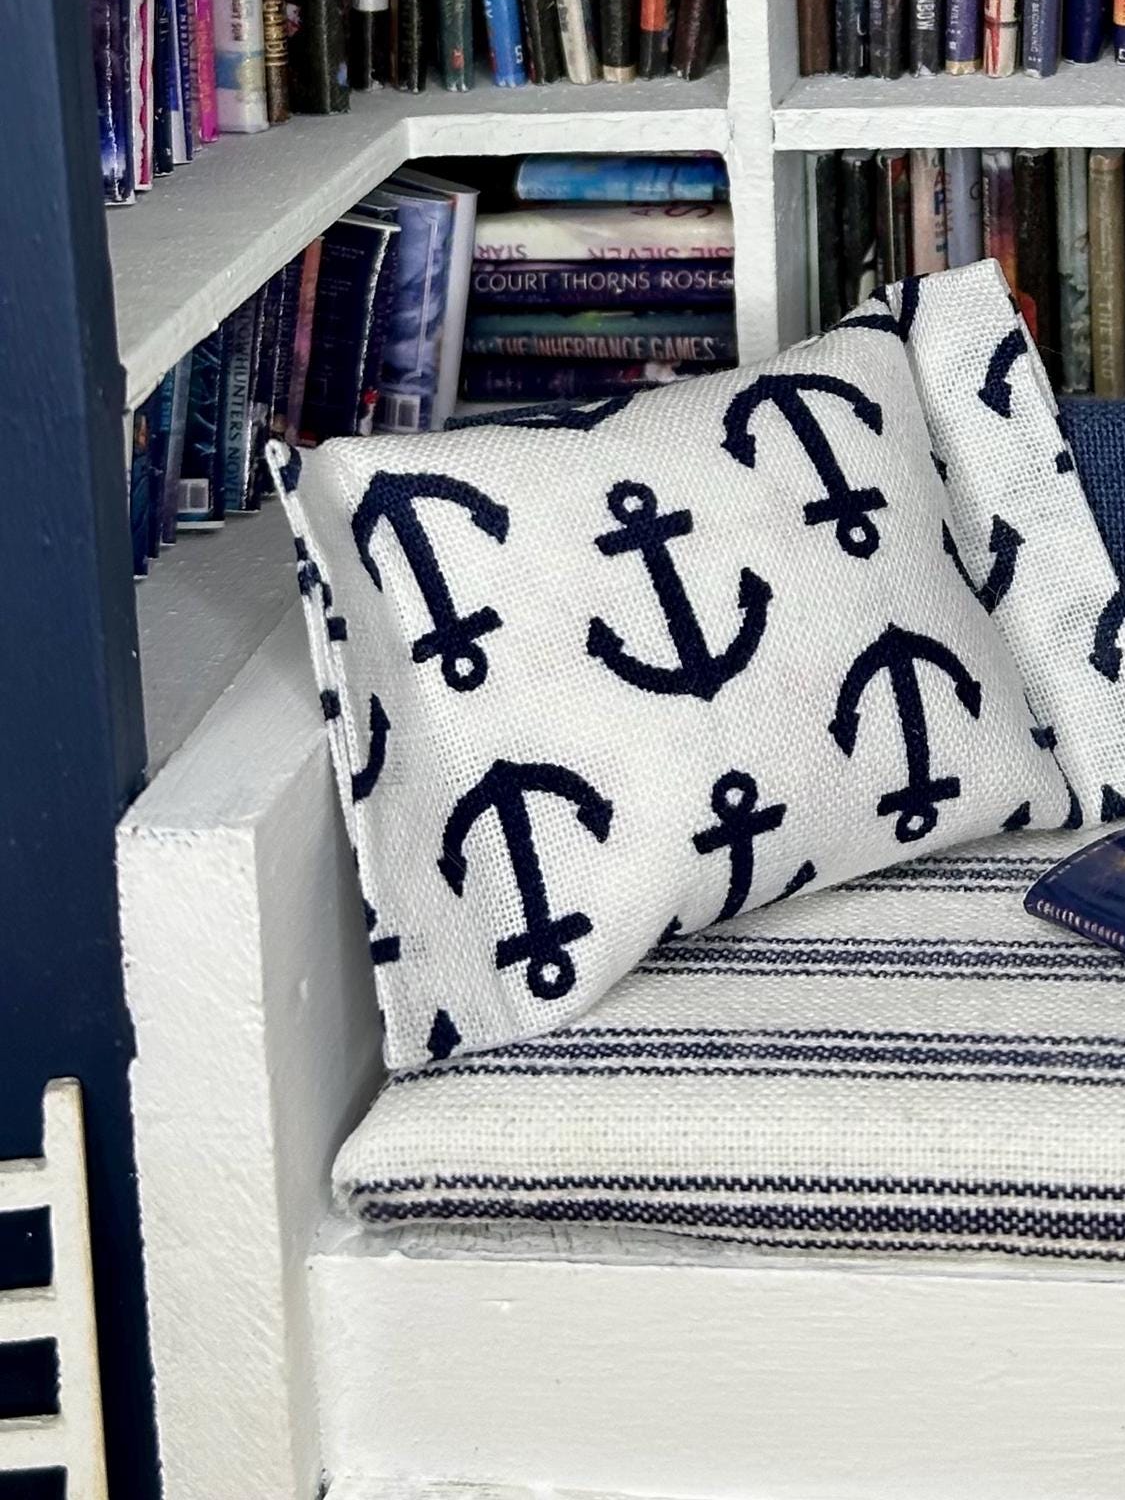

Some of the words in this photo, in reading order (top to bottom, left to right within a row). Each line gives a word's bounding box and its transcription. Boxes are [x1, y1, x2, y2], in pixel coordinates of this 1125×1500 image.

[949, 5, 960, 28] MILL
[1029, 2, 1041, 53] BEGINNING
[478, 243, 527, 260] STAR
[474, 272, 549, 292] COURT
[560, 271, 650, 292] THORNS
[660, 270, 734, 290] ROSES
[1098, 298, 1114, 336] THE
[495, 337, 528, 355] THE
[535, 337, 641, 359] INHERITANCE
[650, 336, 716, 360] GAMES
[1100, 343, 1115, 380] END
